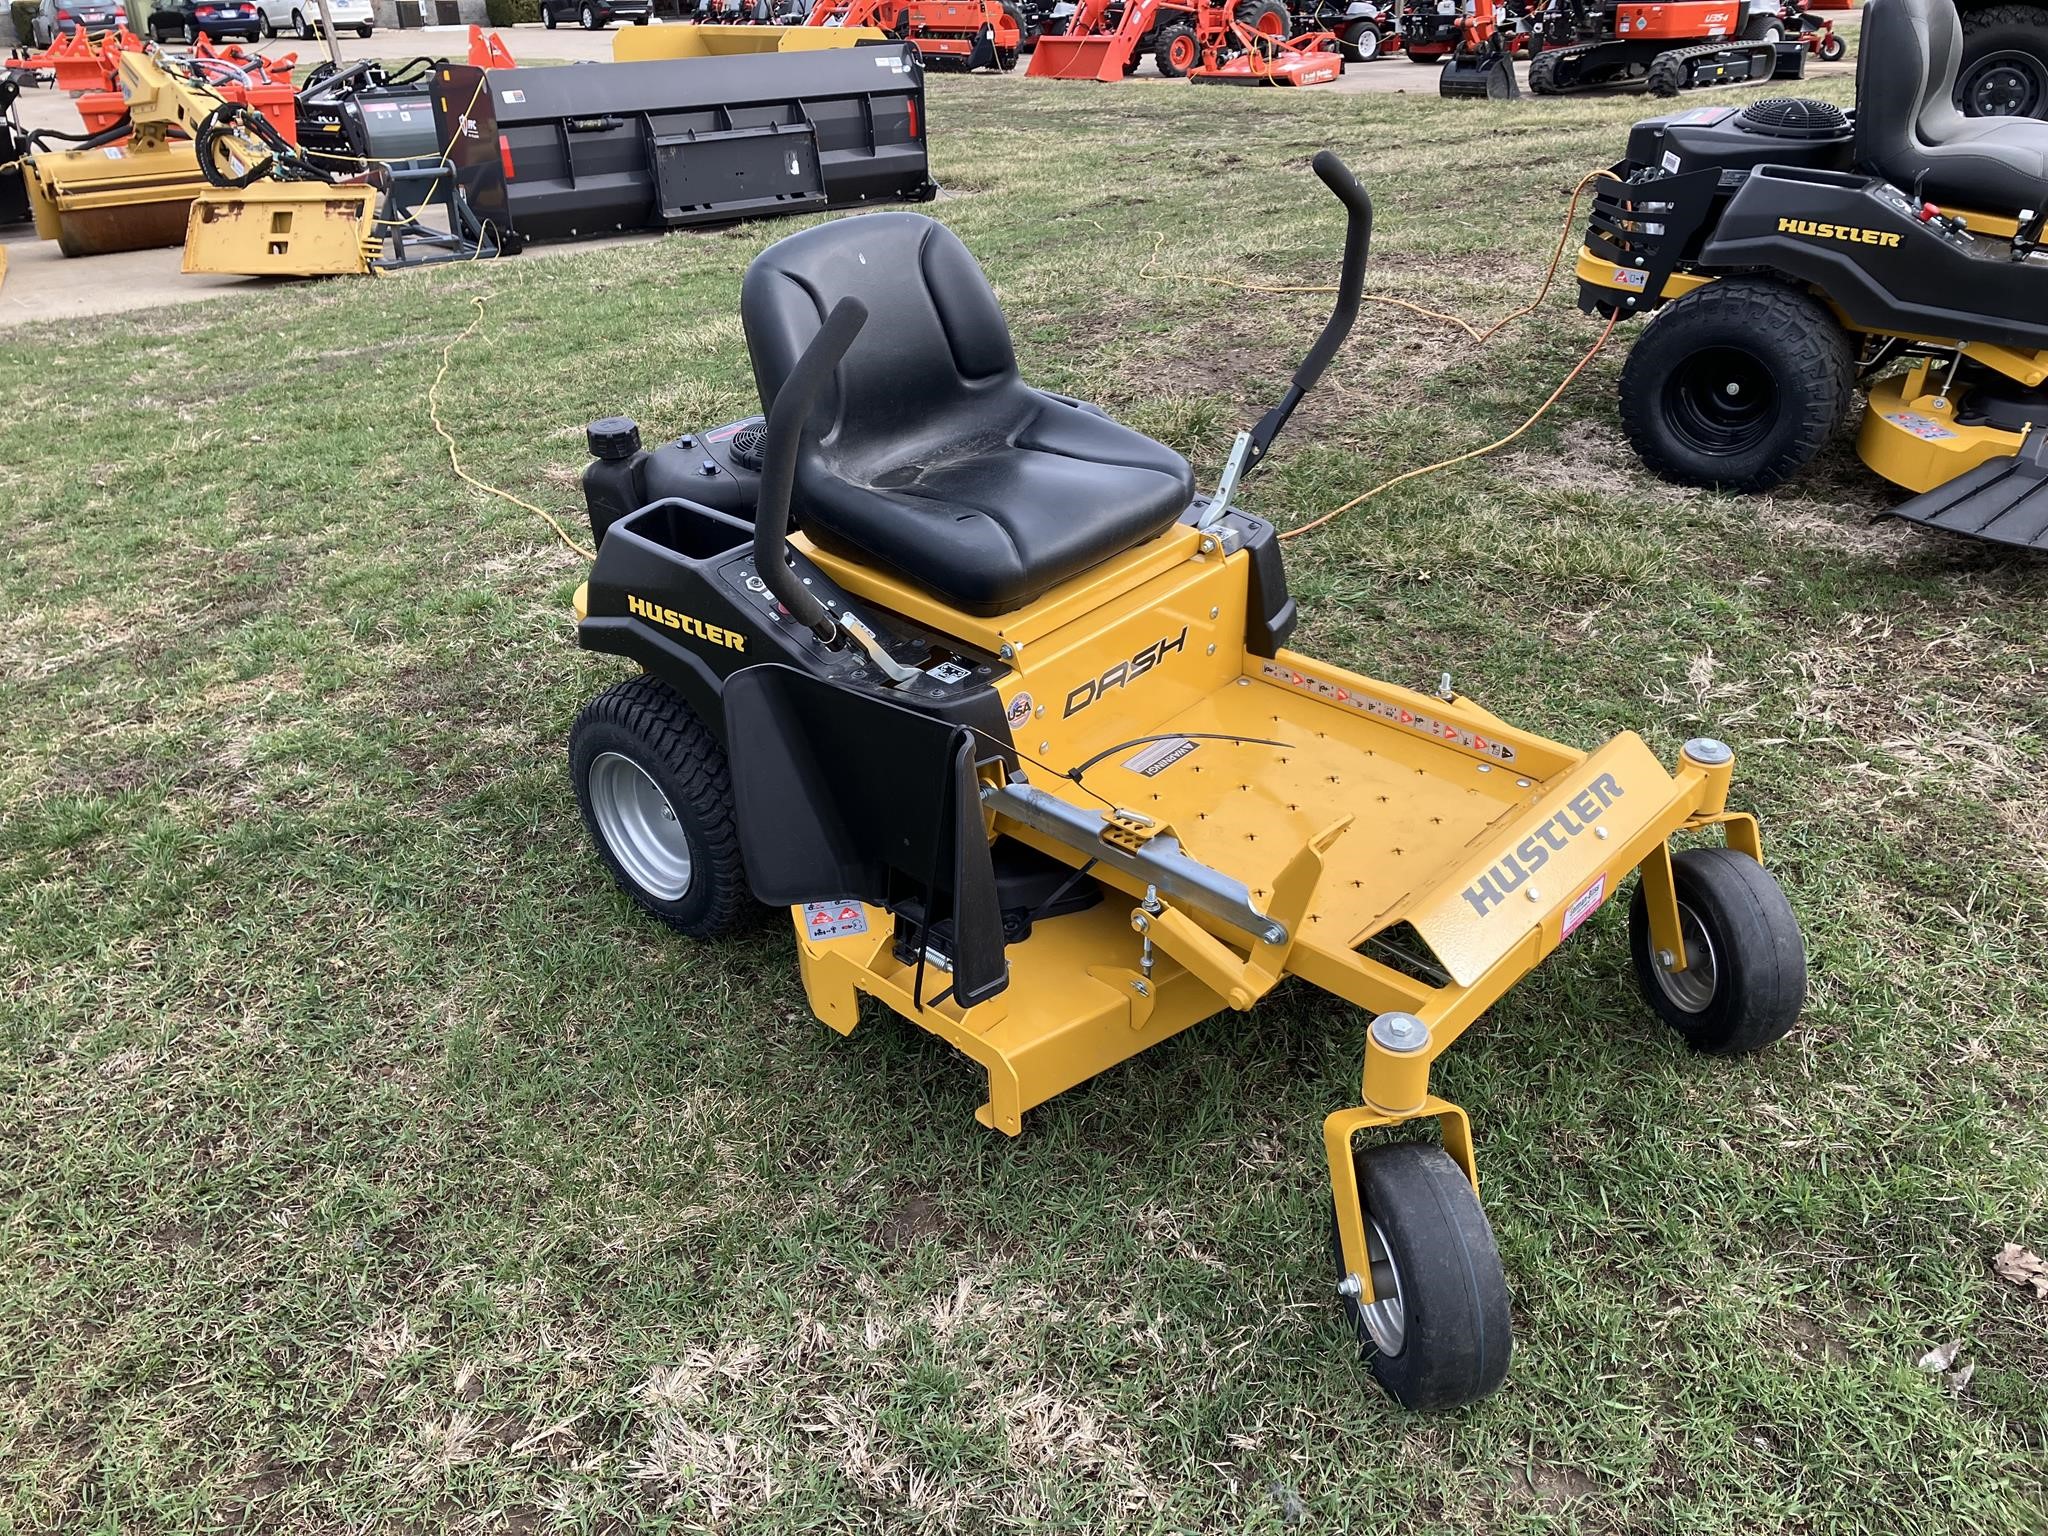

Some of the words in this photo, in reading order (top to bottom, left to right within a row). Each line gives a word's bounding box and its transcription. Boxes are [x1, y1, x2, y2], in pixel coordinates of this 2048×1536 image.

[1778, 217, 1901, 248] HUSTLER
[627, 594, 746, 653] HUSTLER
[1062, 625, 1188, 720] DASH
[1007, 701, 1032, 722] USA
[1461, 772, 1625, 918] HUSTLER
